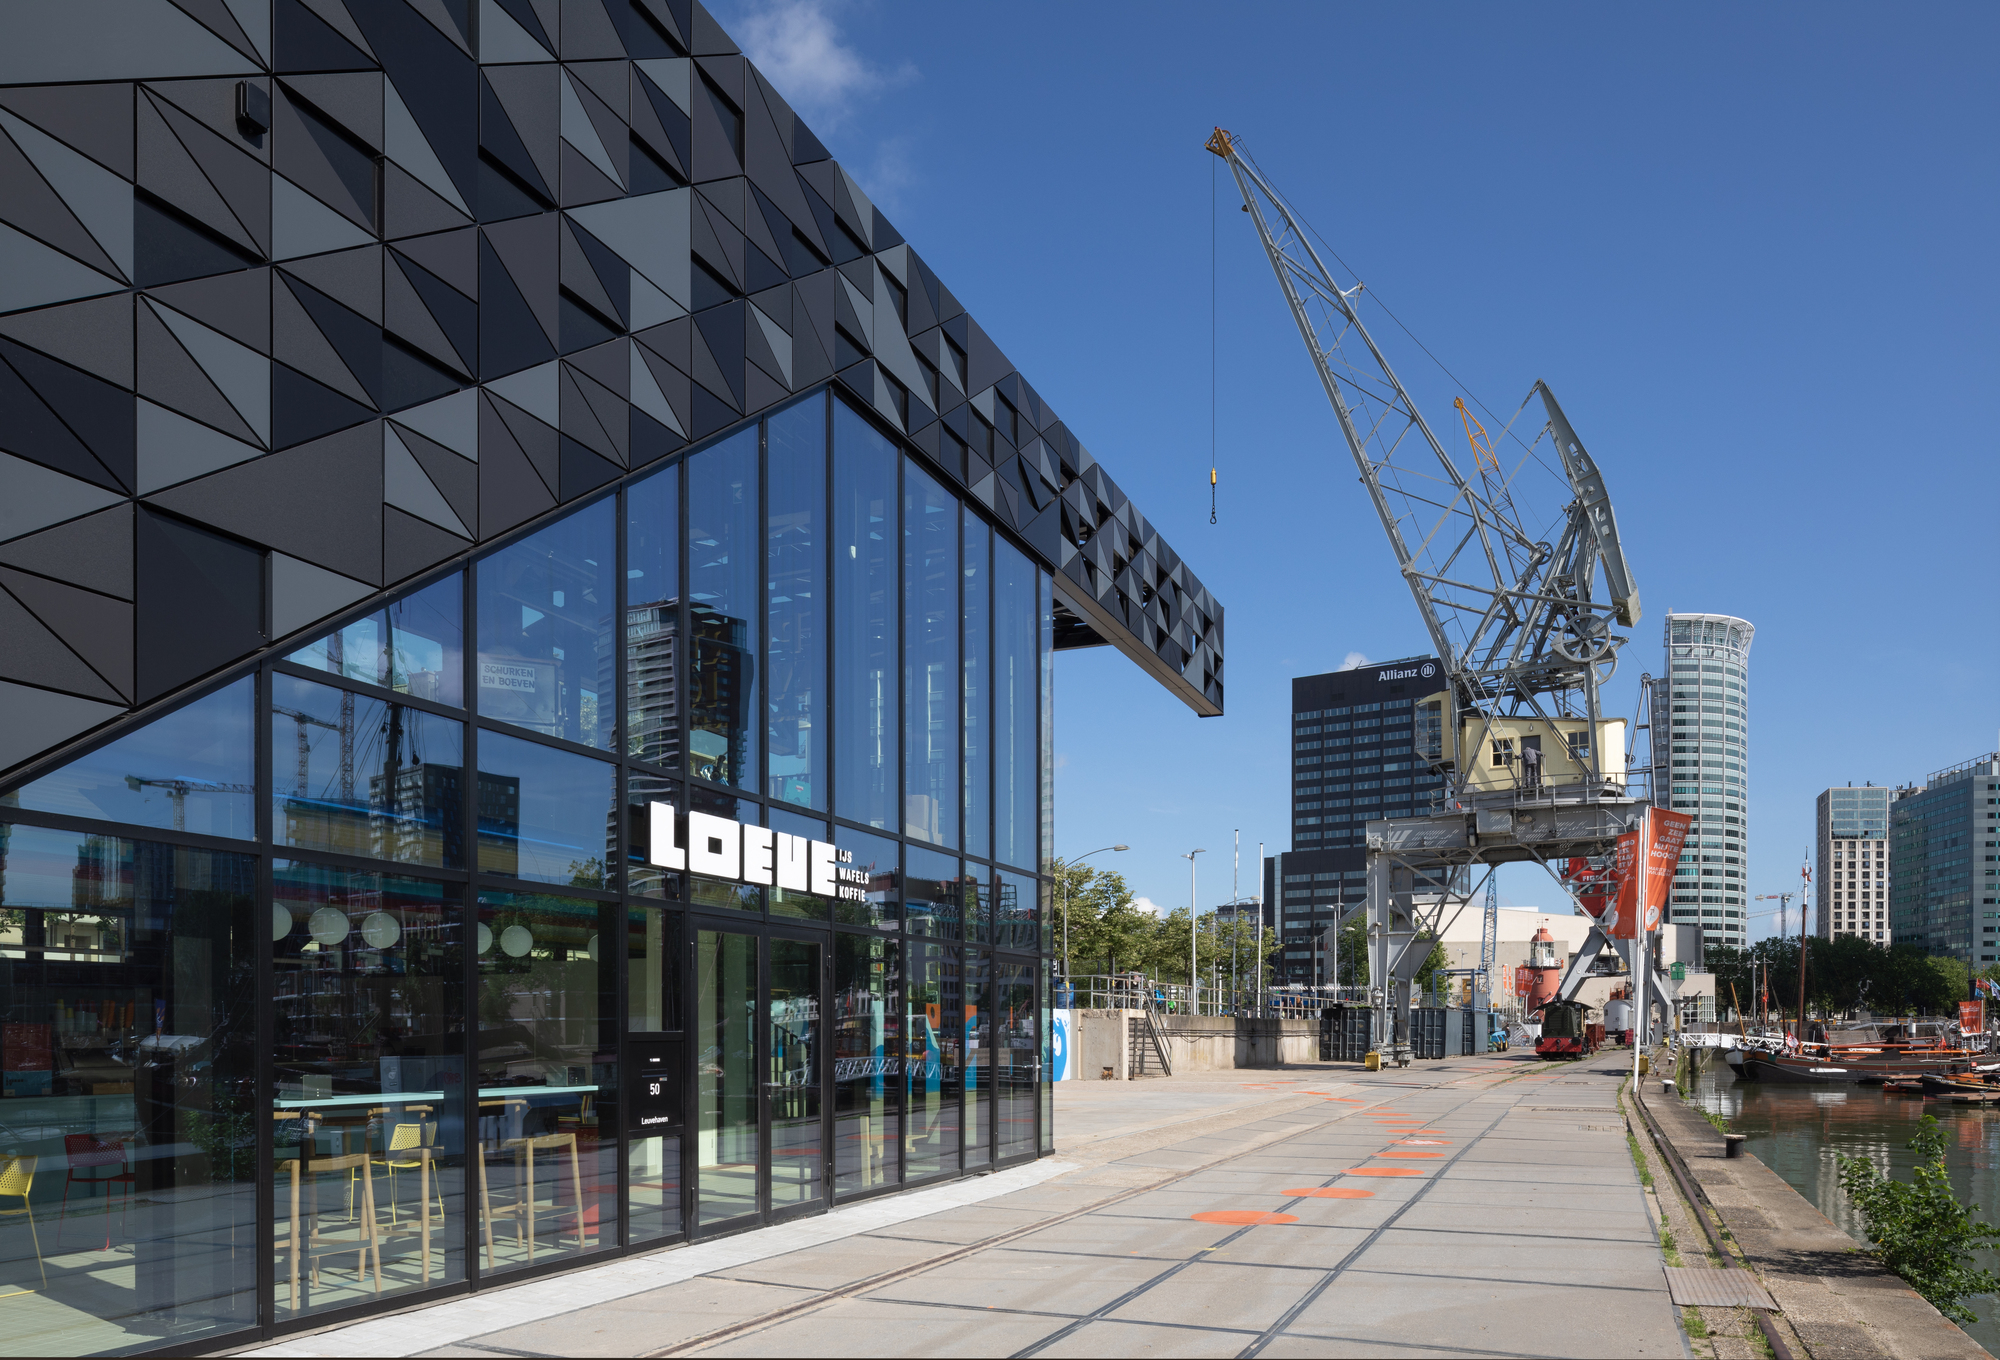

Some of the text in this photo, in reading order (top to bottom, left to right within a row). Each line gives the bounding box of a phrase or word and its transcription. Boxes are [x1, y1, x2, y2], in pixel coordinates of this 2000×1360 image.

[484, 664, 533, 678] SCHURKEN
[1378, 668, 1418, 681] Allianz
[482, 676, 535, 688] EN BOEVEN
[1663, 819, 1686, 830] GEEN
[1668, 828, 1684, 838] ZEE
[1659, 835, 1682, 845] GAAT
[1650, 850, 1677, 860] HOOG!
[1669, 845, 1679, 853] TE
[839, 848, 852, 864] IJS
[839, 867, 870, 885] WAFELS
[839, 885, 866, 902] KOFFIE
[649, 1083, 660, 1096] 50
